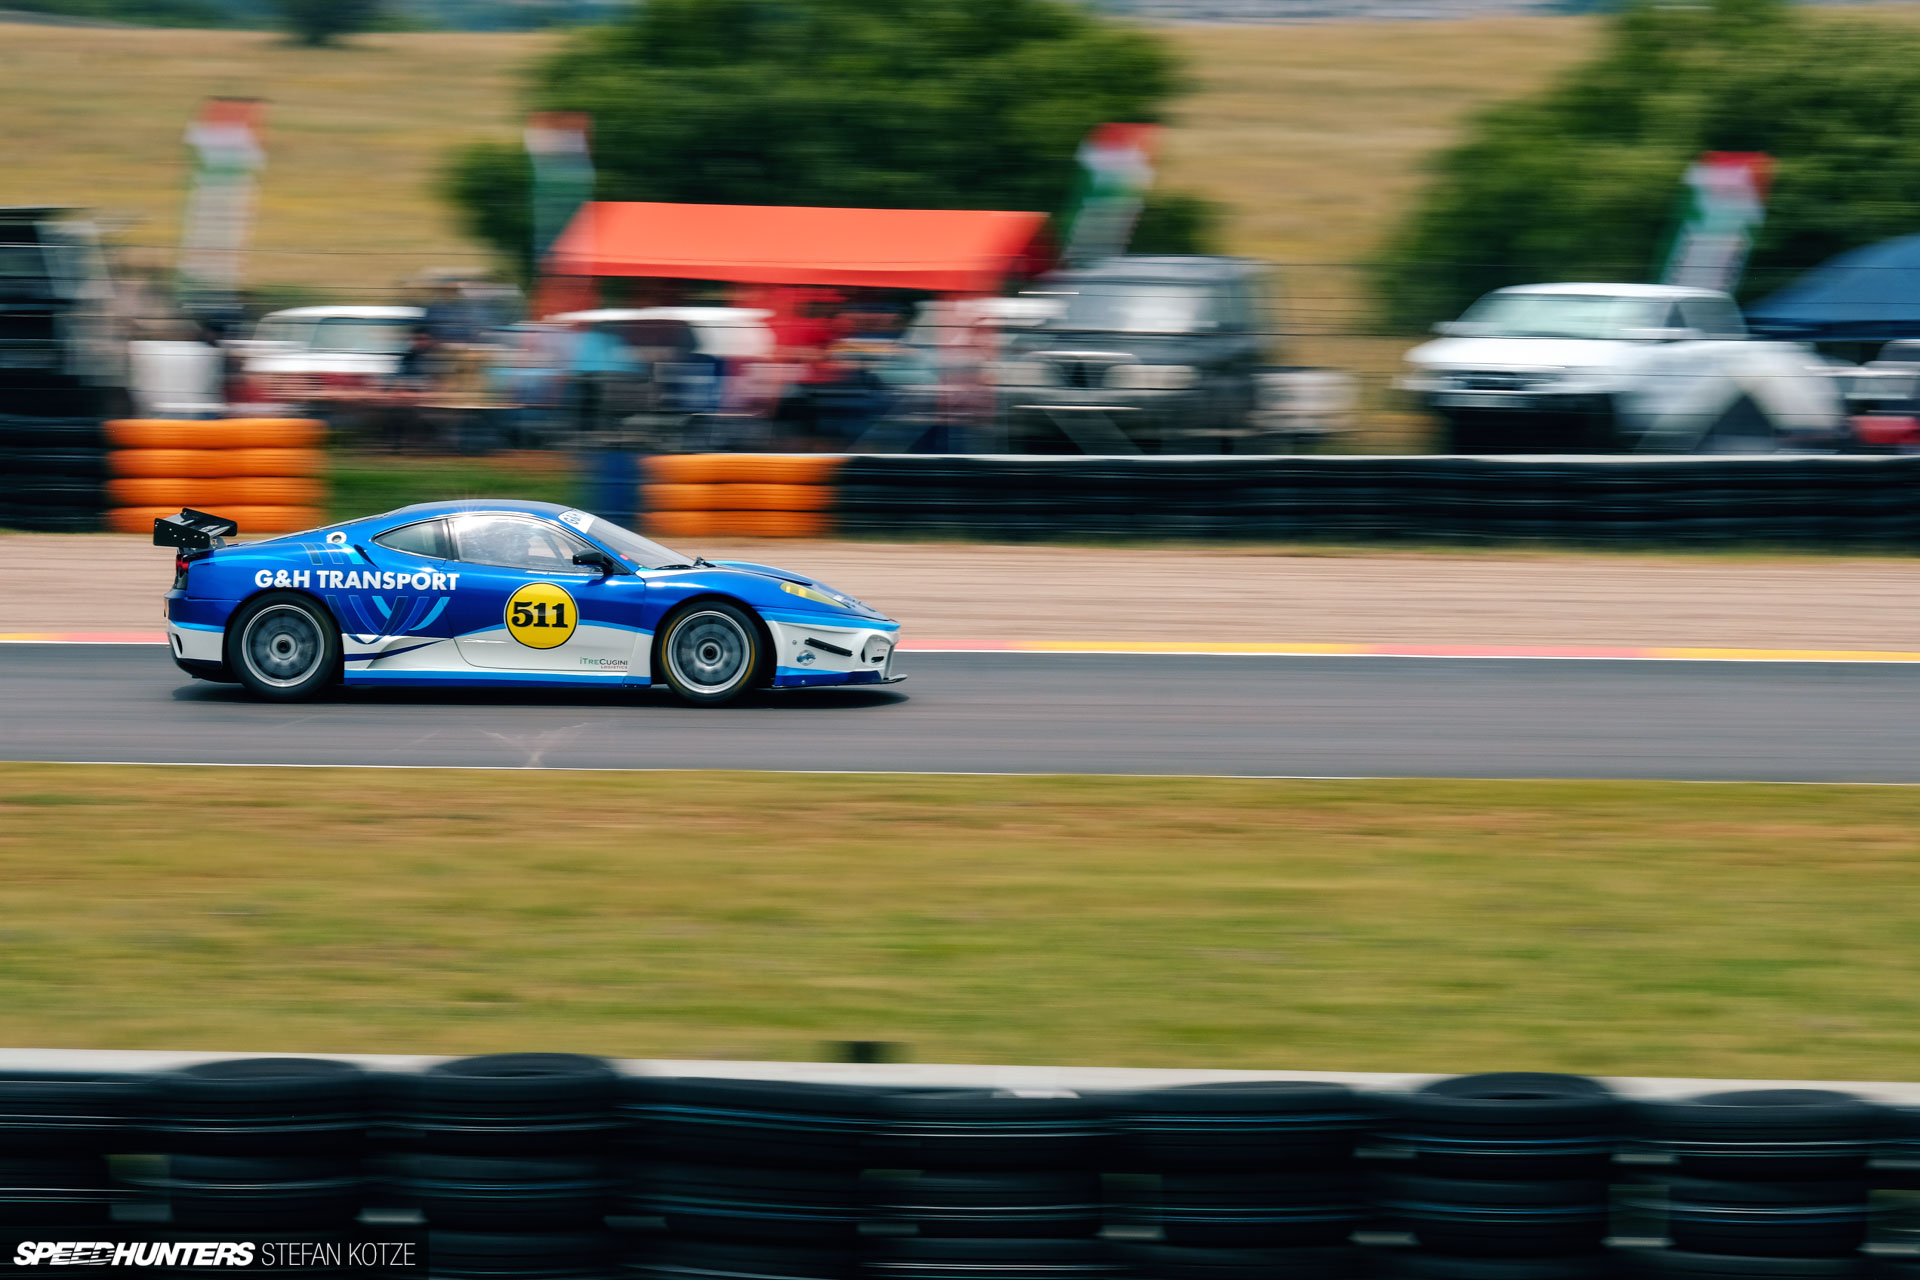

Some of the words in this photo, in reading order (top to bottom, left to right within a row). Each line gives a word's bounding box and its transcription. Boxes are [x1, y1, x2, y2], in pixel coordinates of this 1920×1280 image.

[254, 569, 310, 588] G&H
[316, 570, 460, 590] TRANSPORT
[511, 601, 568, 628] 511
